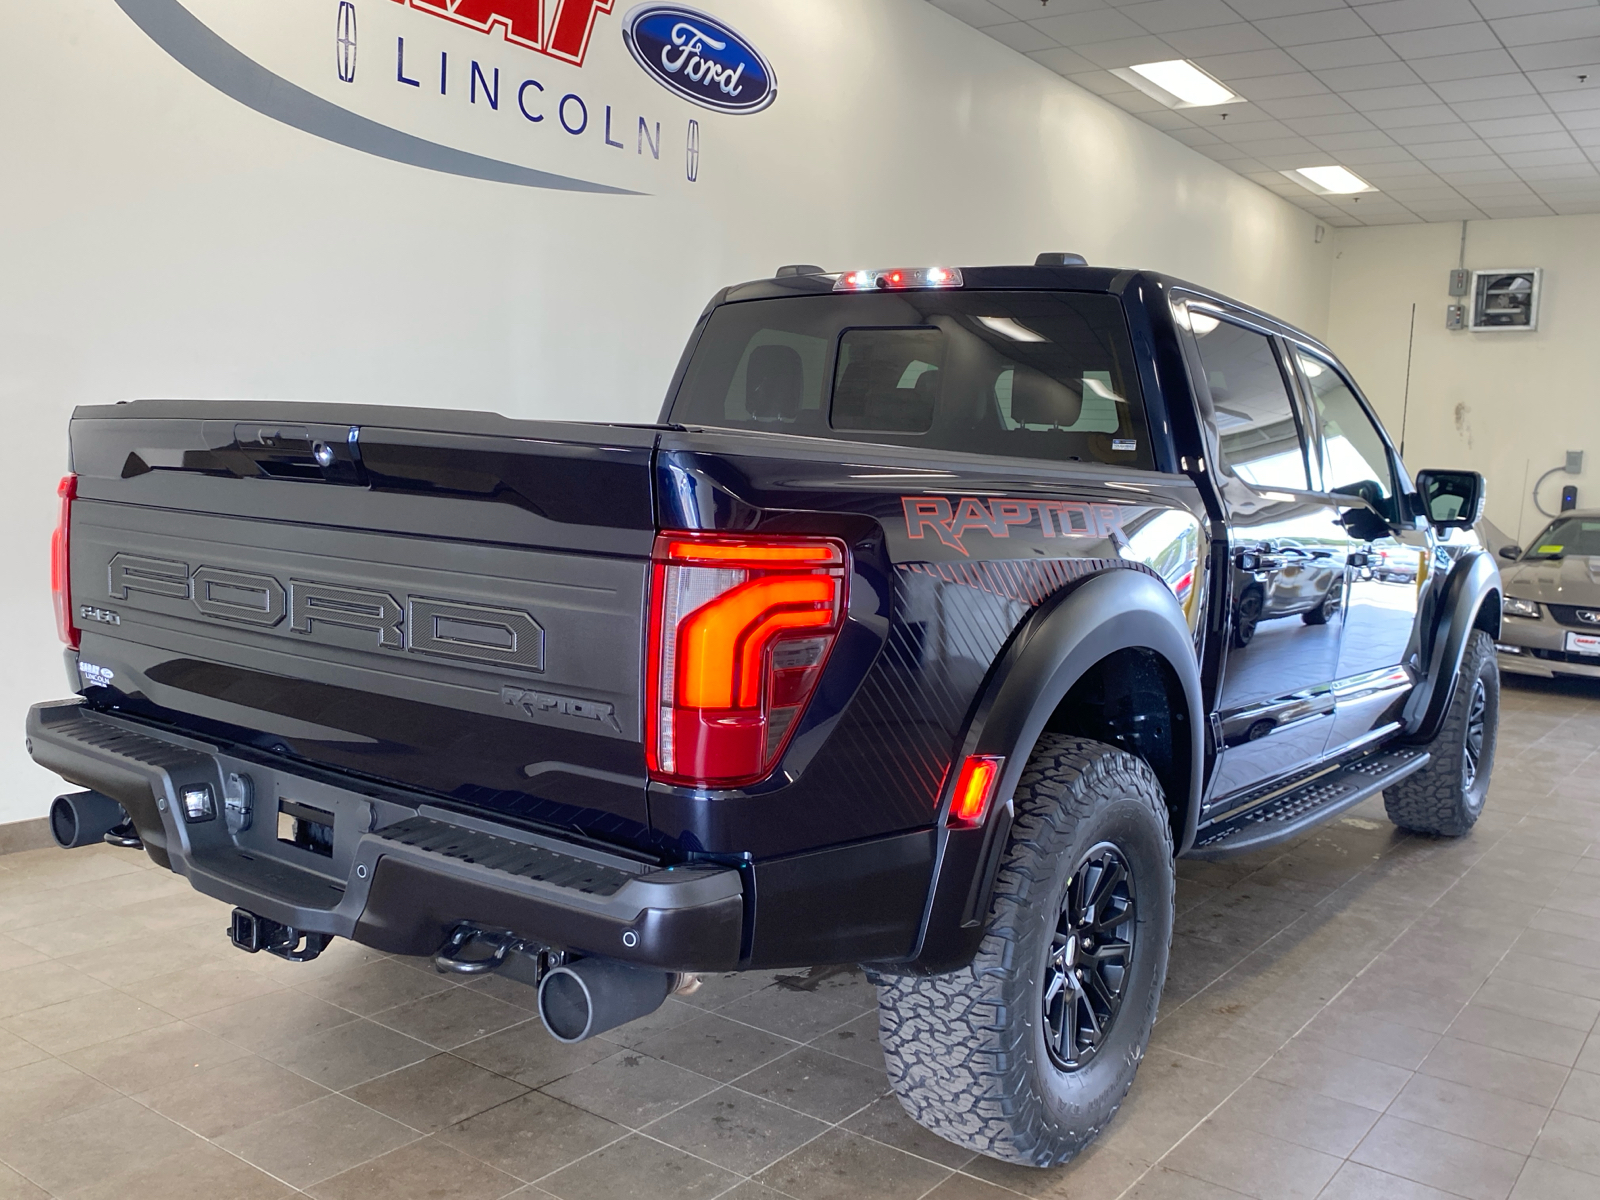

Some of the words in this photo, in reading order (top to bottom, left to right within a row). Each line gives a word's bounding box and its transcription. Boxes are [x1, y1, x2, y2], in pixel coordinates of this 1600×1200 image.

[661, 22, 745, 98] Ford
[396, 36, 661, 161] LINCOLN
[901, 496, 1136, 557] RAPTOR
[108, 551, 546, 674] FORD
[501, 684, 623, 734] RAPTOR
